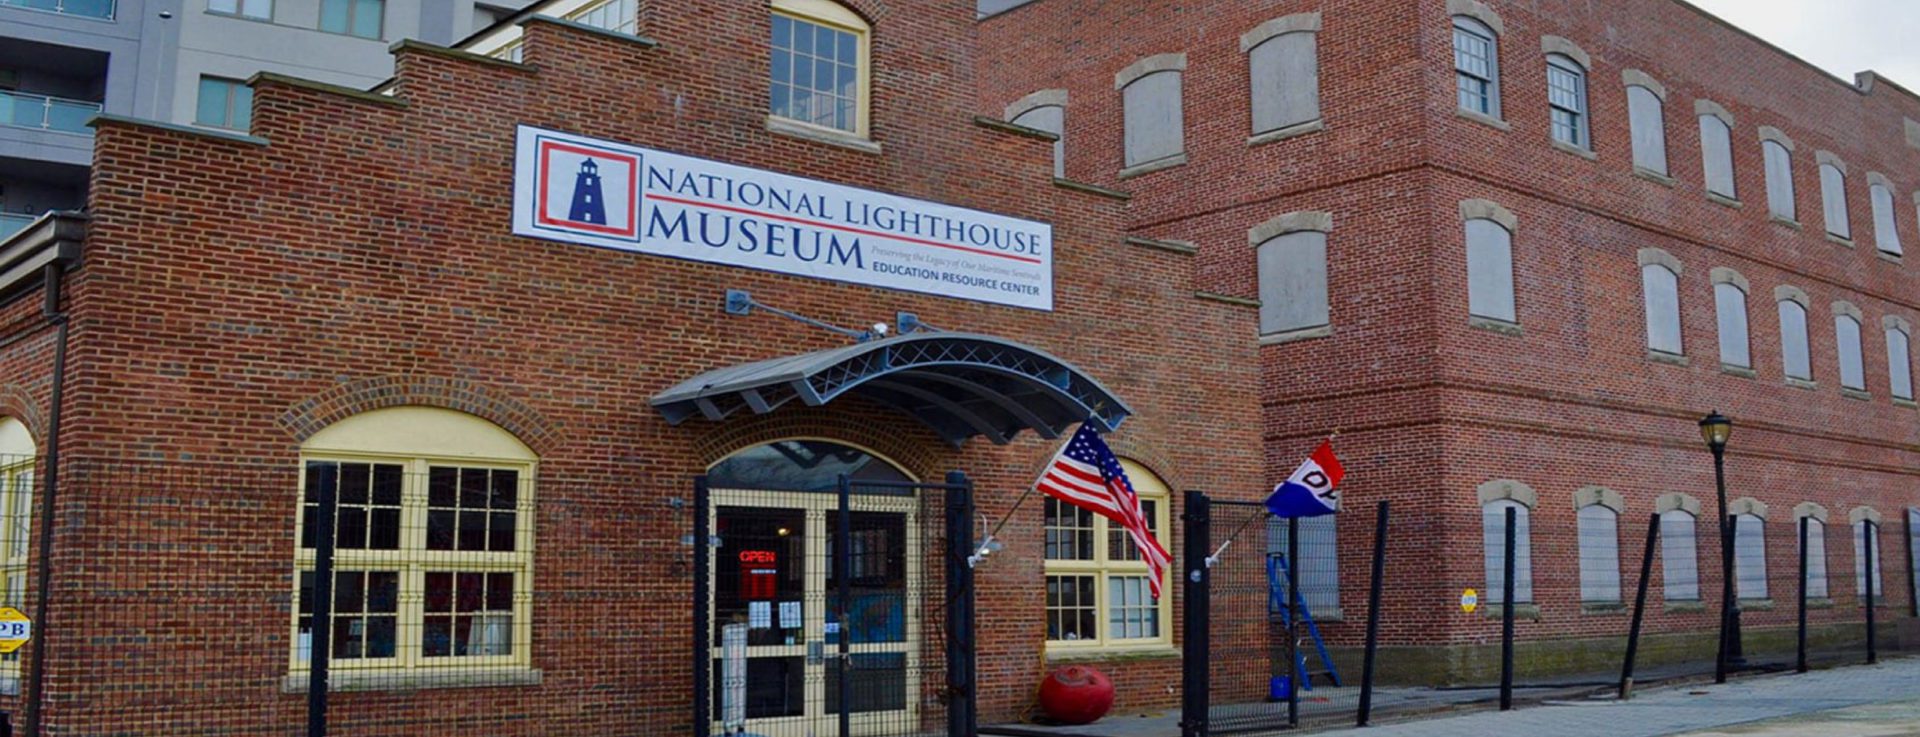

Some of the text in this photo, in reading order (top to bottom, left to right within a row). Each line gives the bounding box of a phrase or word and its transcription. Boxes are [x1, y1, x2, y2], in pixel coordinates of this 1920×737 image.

[648, 165, 1041, 256] NATIONAL LIGHTHOUSE
[645, 204, 866, 270] MUSEUM
[871, 245, 912, 262] Preserving
[913, 251, 925, 261] the
[925, 254, 951, 268] Legacy
[961, 259, 977, 270] Our
[872, 261, 1040, 297] EDUCATION RESOURCE CENTER
[739, 550, 776, 562] OPEN
